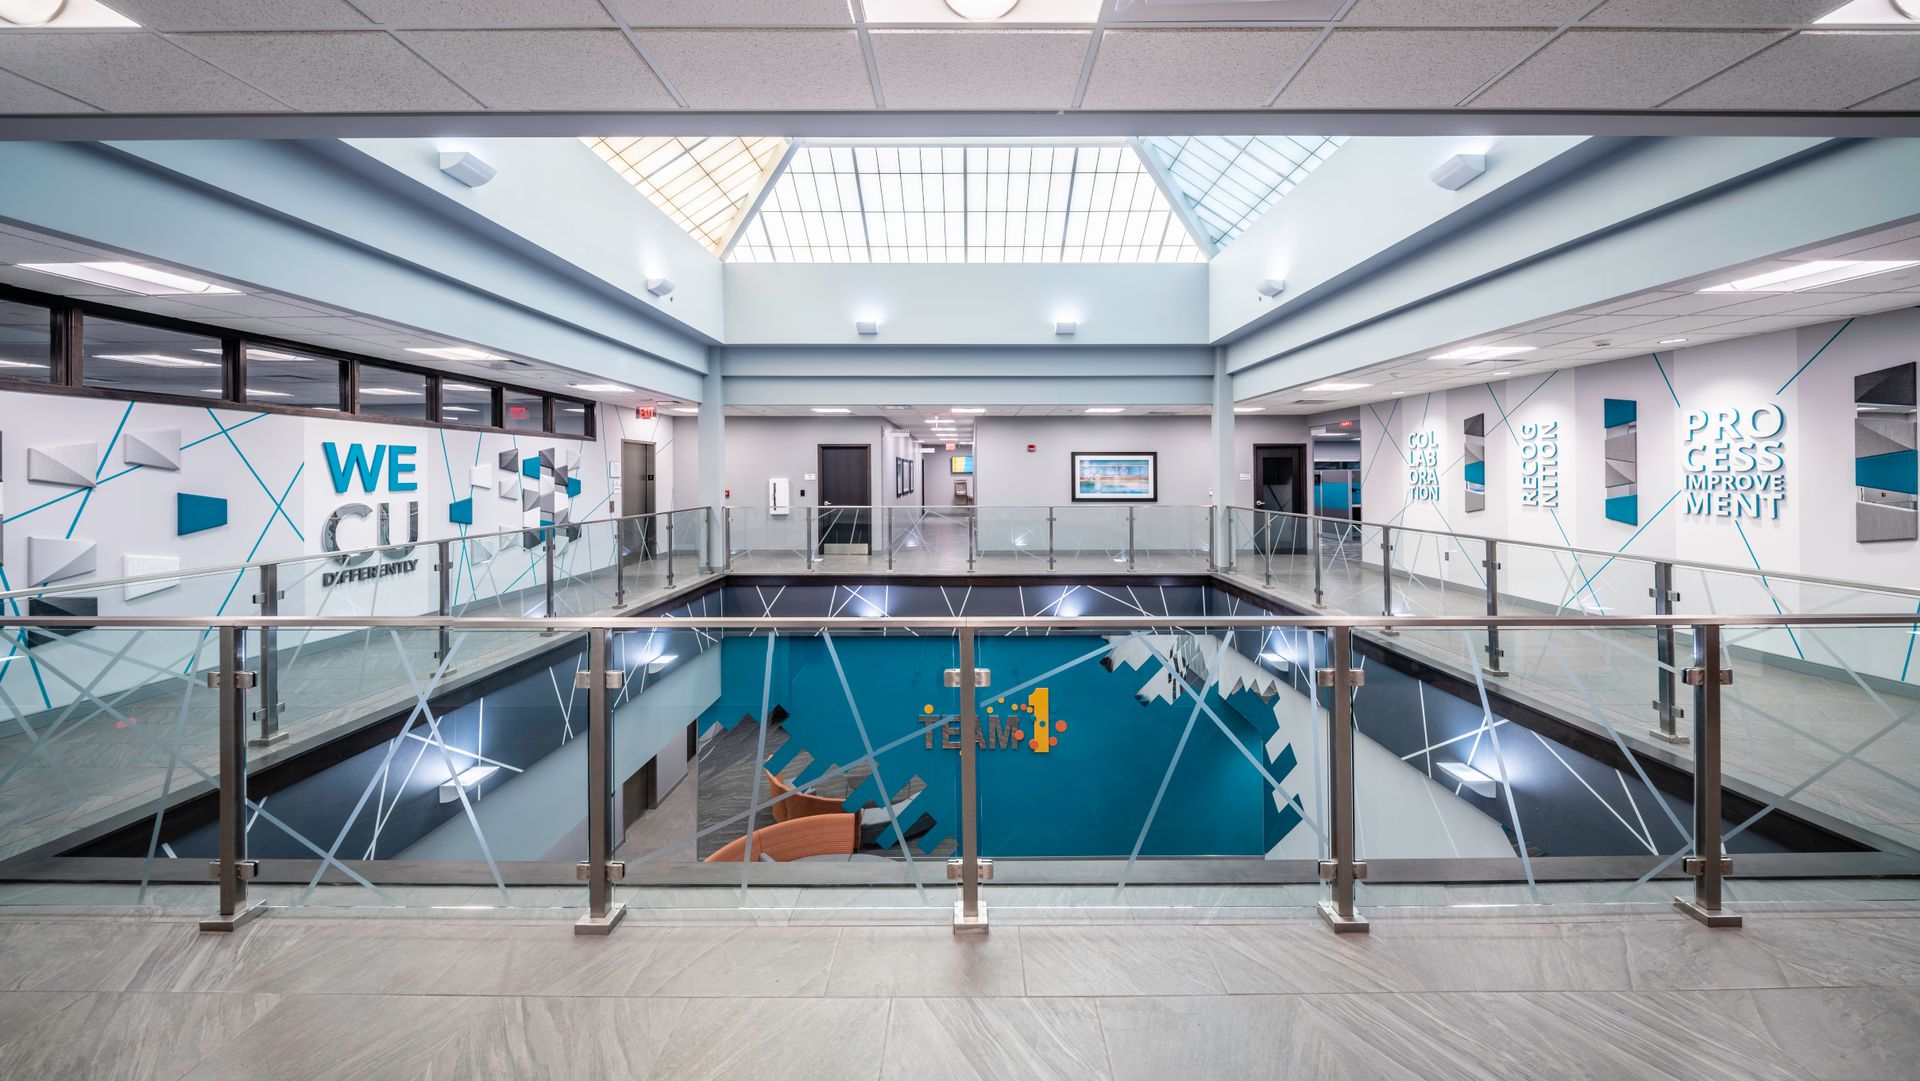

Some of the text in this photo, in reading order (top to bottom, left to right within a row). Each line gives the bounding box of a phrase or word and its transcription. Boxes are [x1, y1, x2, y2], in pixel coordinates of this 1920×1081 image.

[1683, 403, 1785, 442] PRO
[1408, 430, 1439, 449] COL
[322, 441, 417, 493] WE
[1409, 450, 1438, 467] LAB
[1521, 423, 1539, 507] RECOG
[1541, 421, 1558, 508] NITION
[1682, 441, 1785, 473] CESS
[1409, 468, 1439, 485] ORA
[1684, 474, 1785, 492] IMPROVE
[1409, 486, 1440, 501] TION
[1682, 492, 1785, 520] MENT
[322, 501, 418, 566] CU
[322, 559, 419, 587] DIFFERENTLY
[1028, 687, 1049, 753] 1
